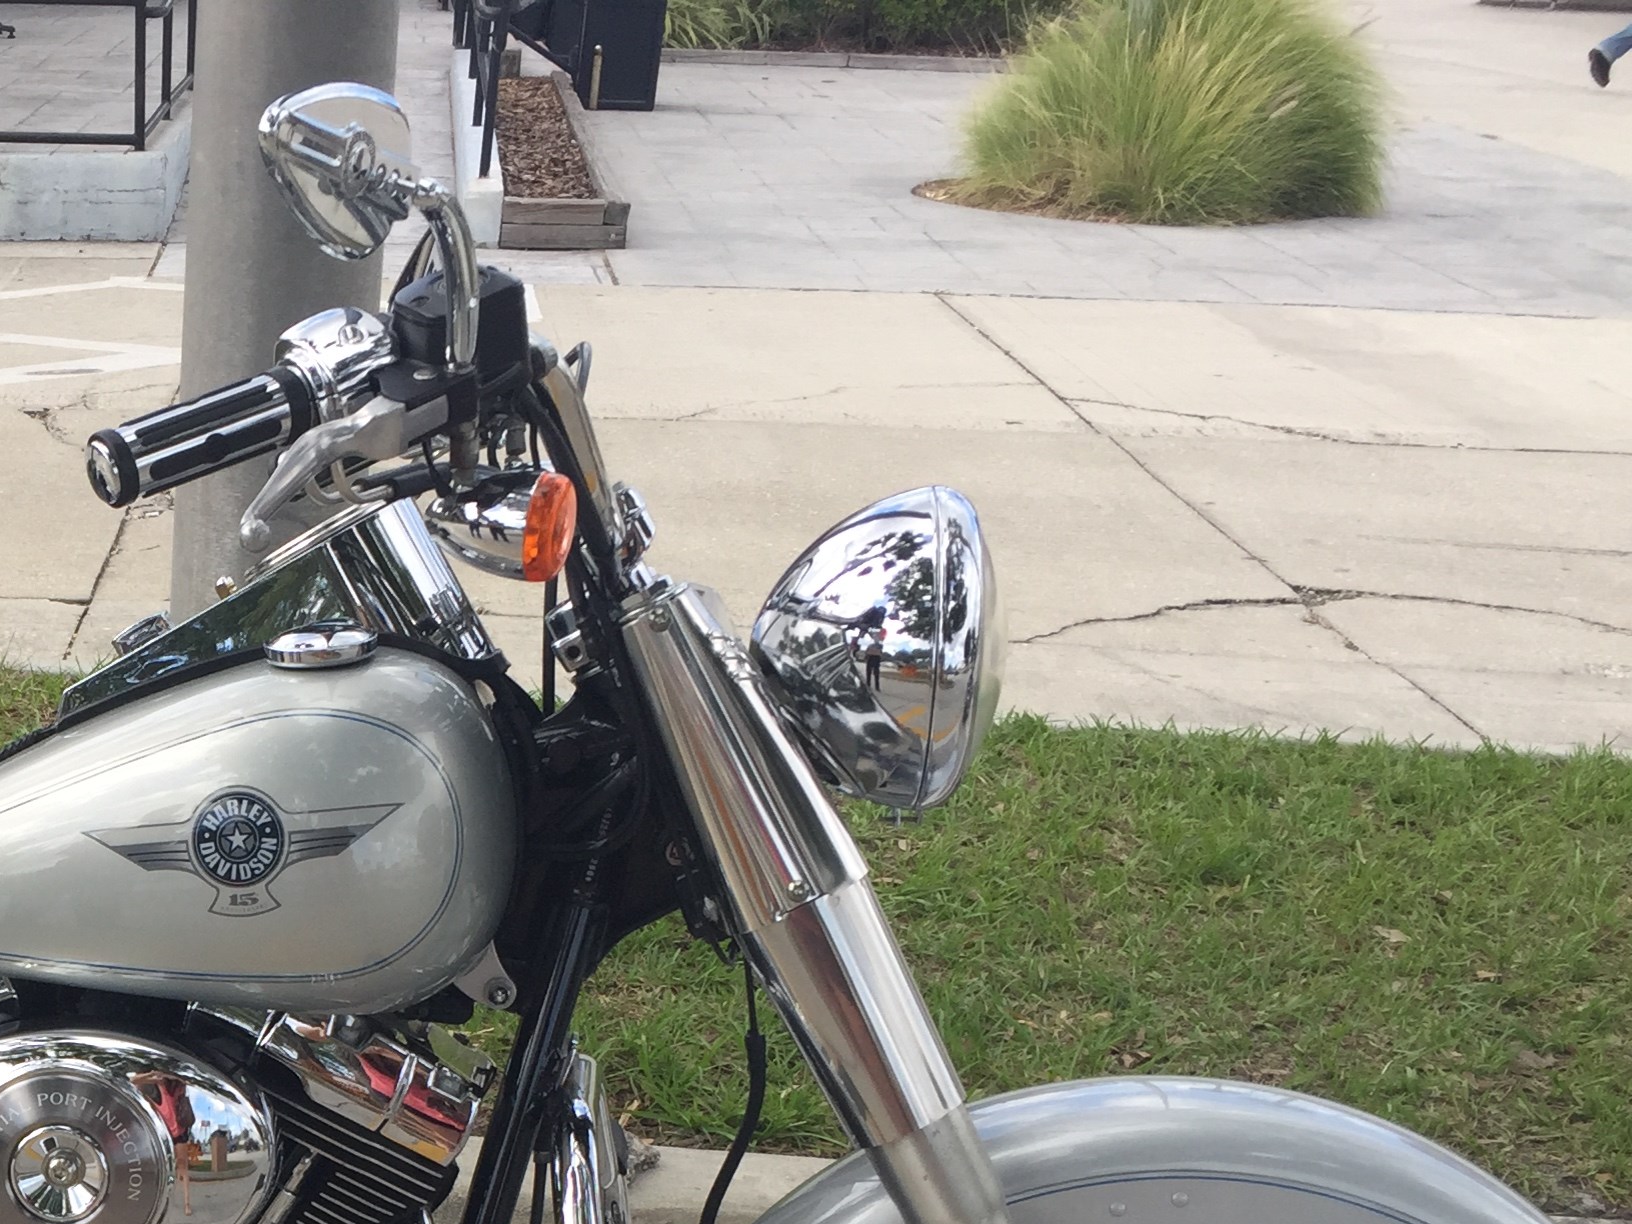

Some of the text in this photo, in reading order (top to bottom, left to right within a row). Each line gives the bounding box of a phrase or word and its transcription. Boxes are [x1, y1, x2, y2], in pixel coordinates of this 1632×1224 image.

[202, 799, 272, 831] HARLEY
[199, 837, 278, 880] DAVIDSON
[229, 892, 259, 906] 15
[37, 1092, 92, 1111] PORT
[95, 1106, 143, 1201] INJECTION
